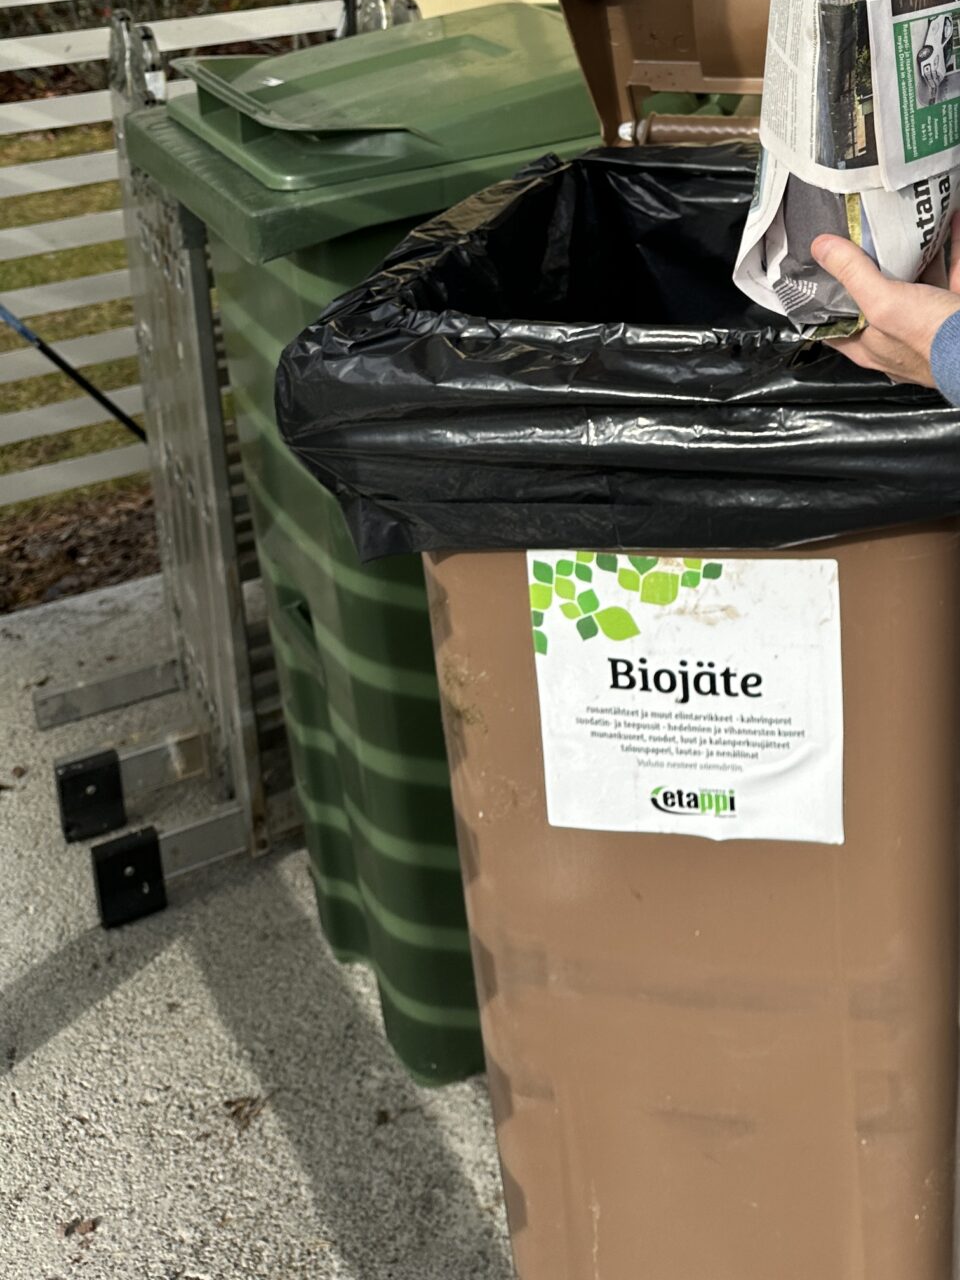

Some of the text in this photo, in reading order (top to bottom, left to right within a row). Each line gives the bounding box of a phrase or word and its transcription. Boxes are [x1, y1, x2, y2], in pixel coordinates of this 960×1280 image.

[608, 657, 763, 704] Biojäte
[641, 708, 649, 719] ja
[650, 710, 673, 719] muut
[614, 719, 622, 729] ja
[713, 725, 721, 736] ja
[699, 736, 708, 747] ja
[705, 748, 714, 759] ja
[662, 789, 735, 816] etappi
